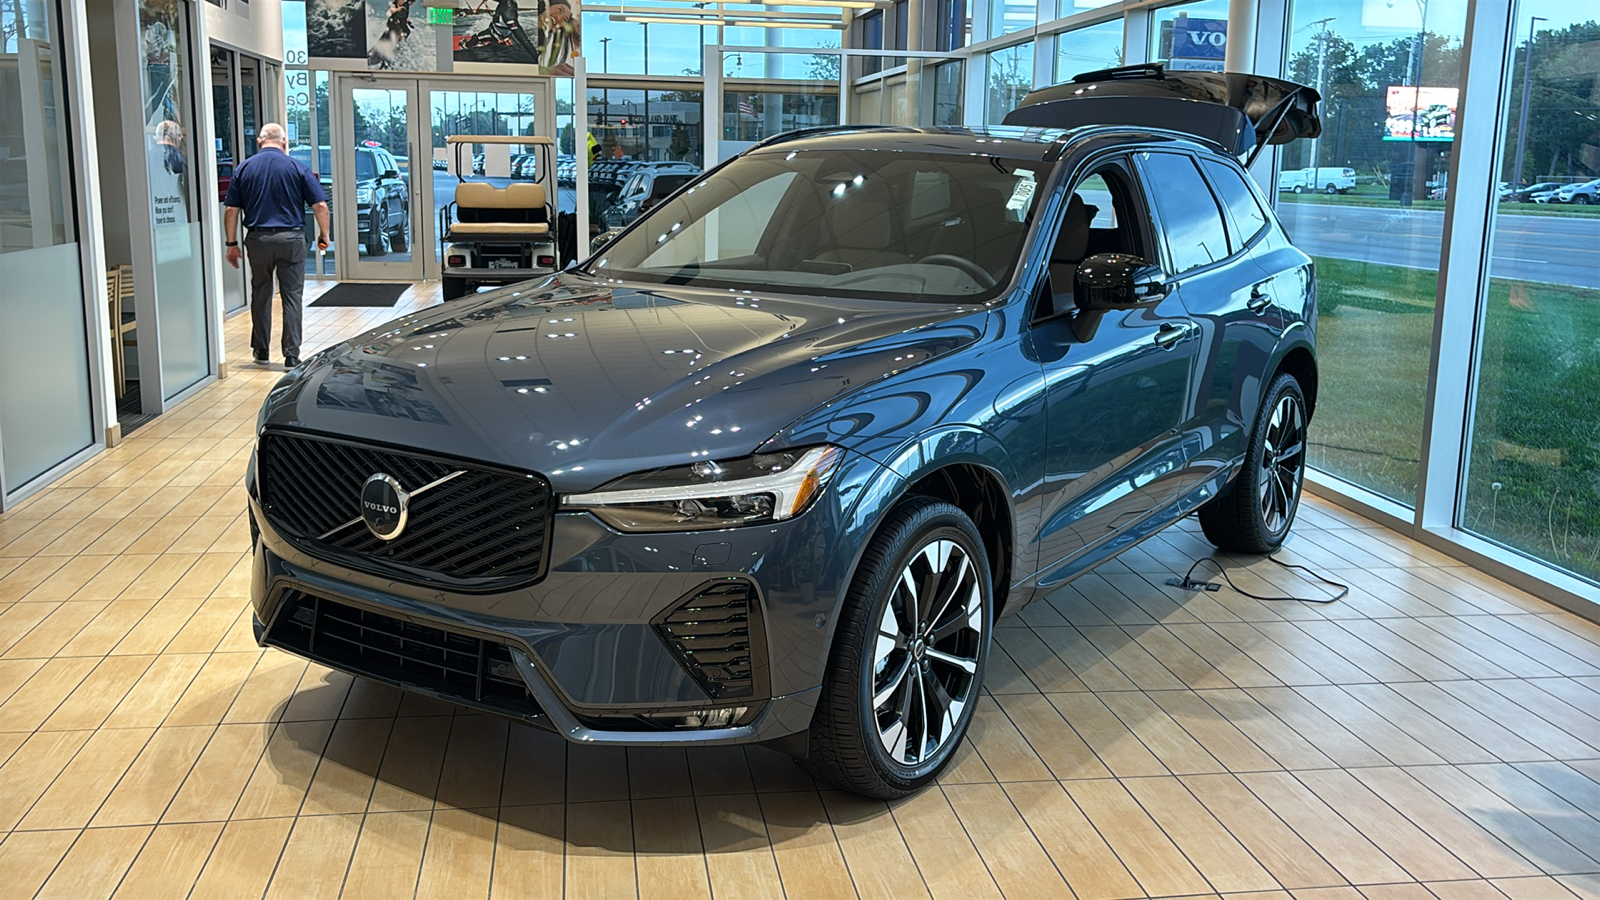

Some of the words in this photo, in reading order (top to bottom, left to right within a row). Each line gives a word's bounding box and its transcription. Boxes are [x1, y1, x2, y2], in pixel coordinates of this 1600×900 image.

[430, 8, 453, 23] EXIT
[1187, 31, 1226, 46] VO
[364, 500, 397, 514] VOLVO
